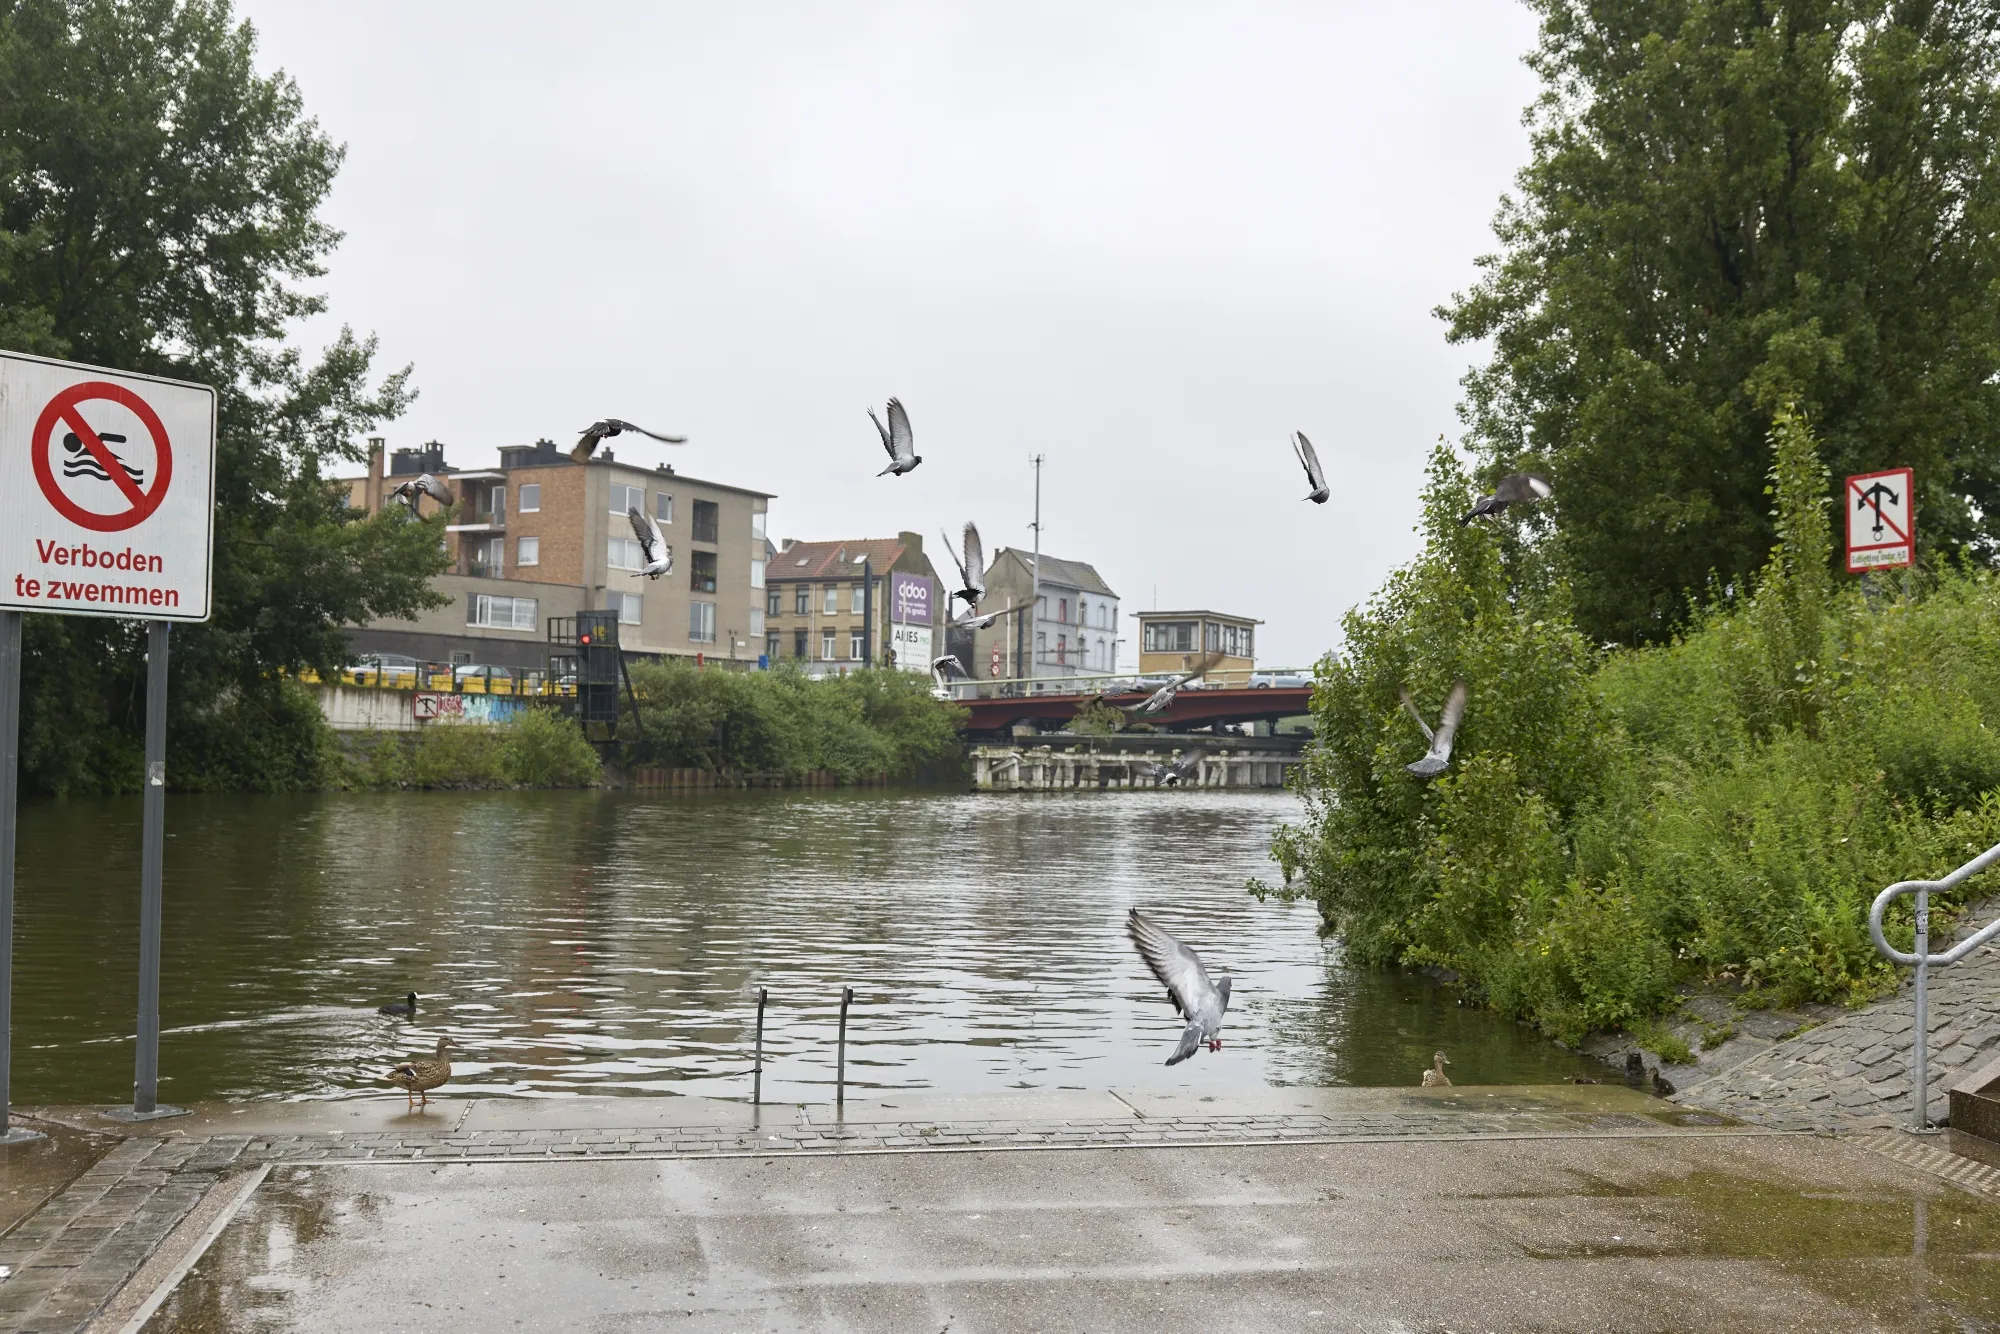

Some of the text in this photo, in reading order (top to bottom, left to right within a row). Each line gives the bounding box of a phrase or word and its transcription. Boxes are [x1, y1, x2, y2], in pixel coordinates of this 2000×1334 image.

[35, 538, 163, 573] Verboden
[15, 573, 179, 607] te zwemmen
